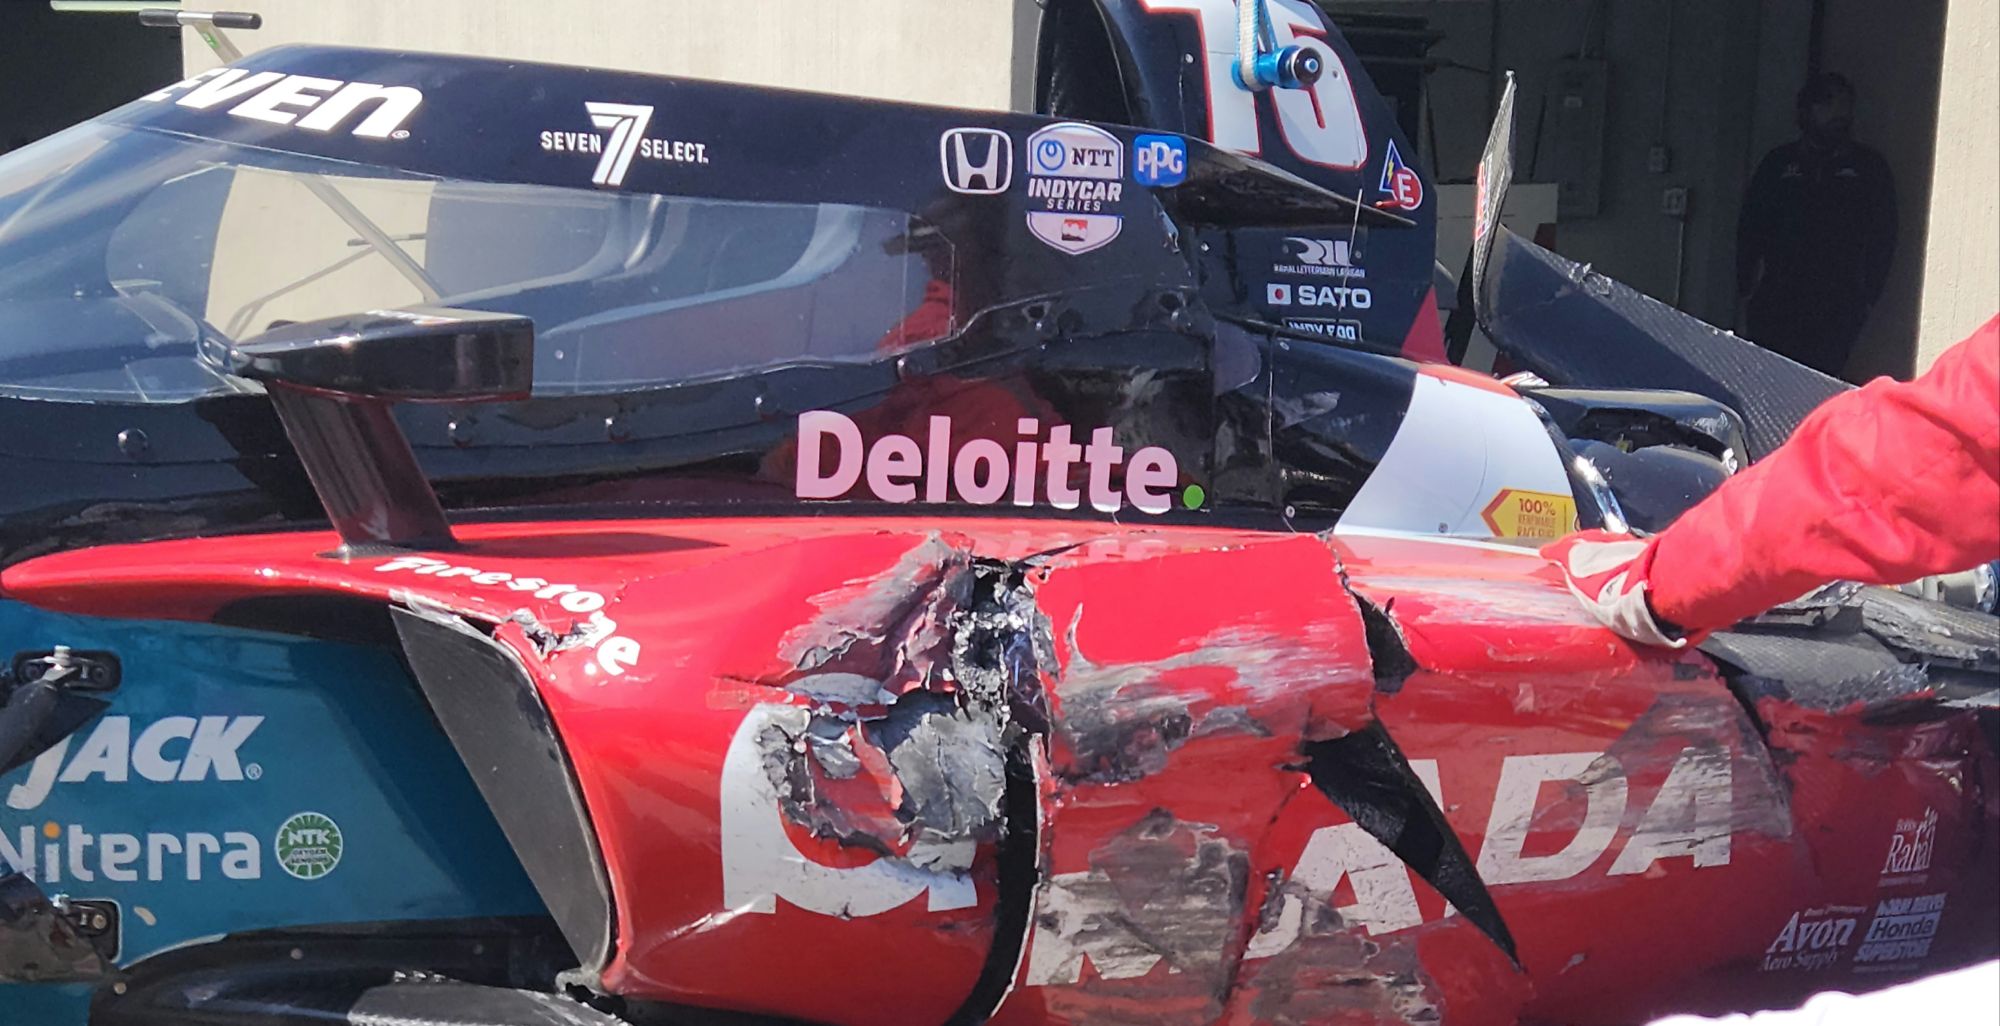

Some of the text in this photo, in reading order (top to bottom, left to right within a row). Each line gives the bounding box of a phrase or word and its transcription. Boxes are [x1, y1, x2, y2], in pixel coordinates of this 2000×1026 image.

[540, 131, 602, 153] SEVEN
[1072, 148, 1114, 167] NTT
[1138, 142, 1183, 179] PPG
[1028, 178, 1122, 202] INDYCAR
[1047, 198, 1101, 212] SERIES
[1298, 285, 1372, 309] SATO
[1519, 498, 1556, 516] 100%
[288, 829, 331, 846] NTK
[1765, 911, 1857, 953] Avon
[1871, 917, 1935, 940] Honda
